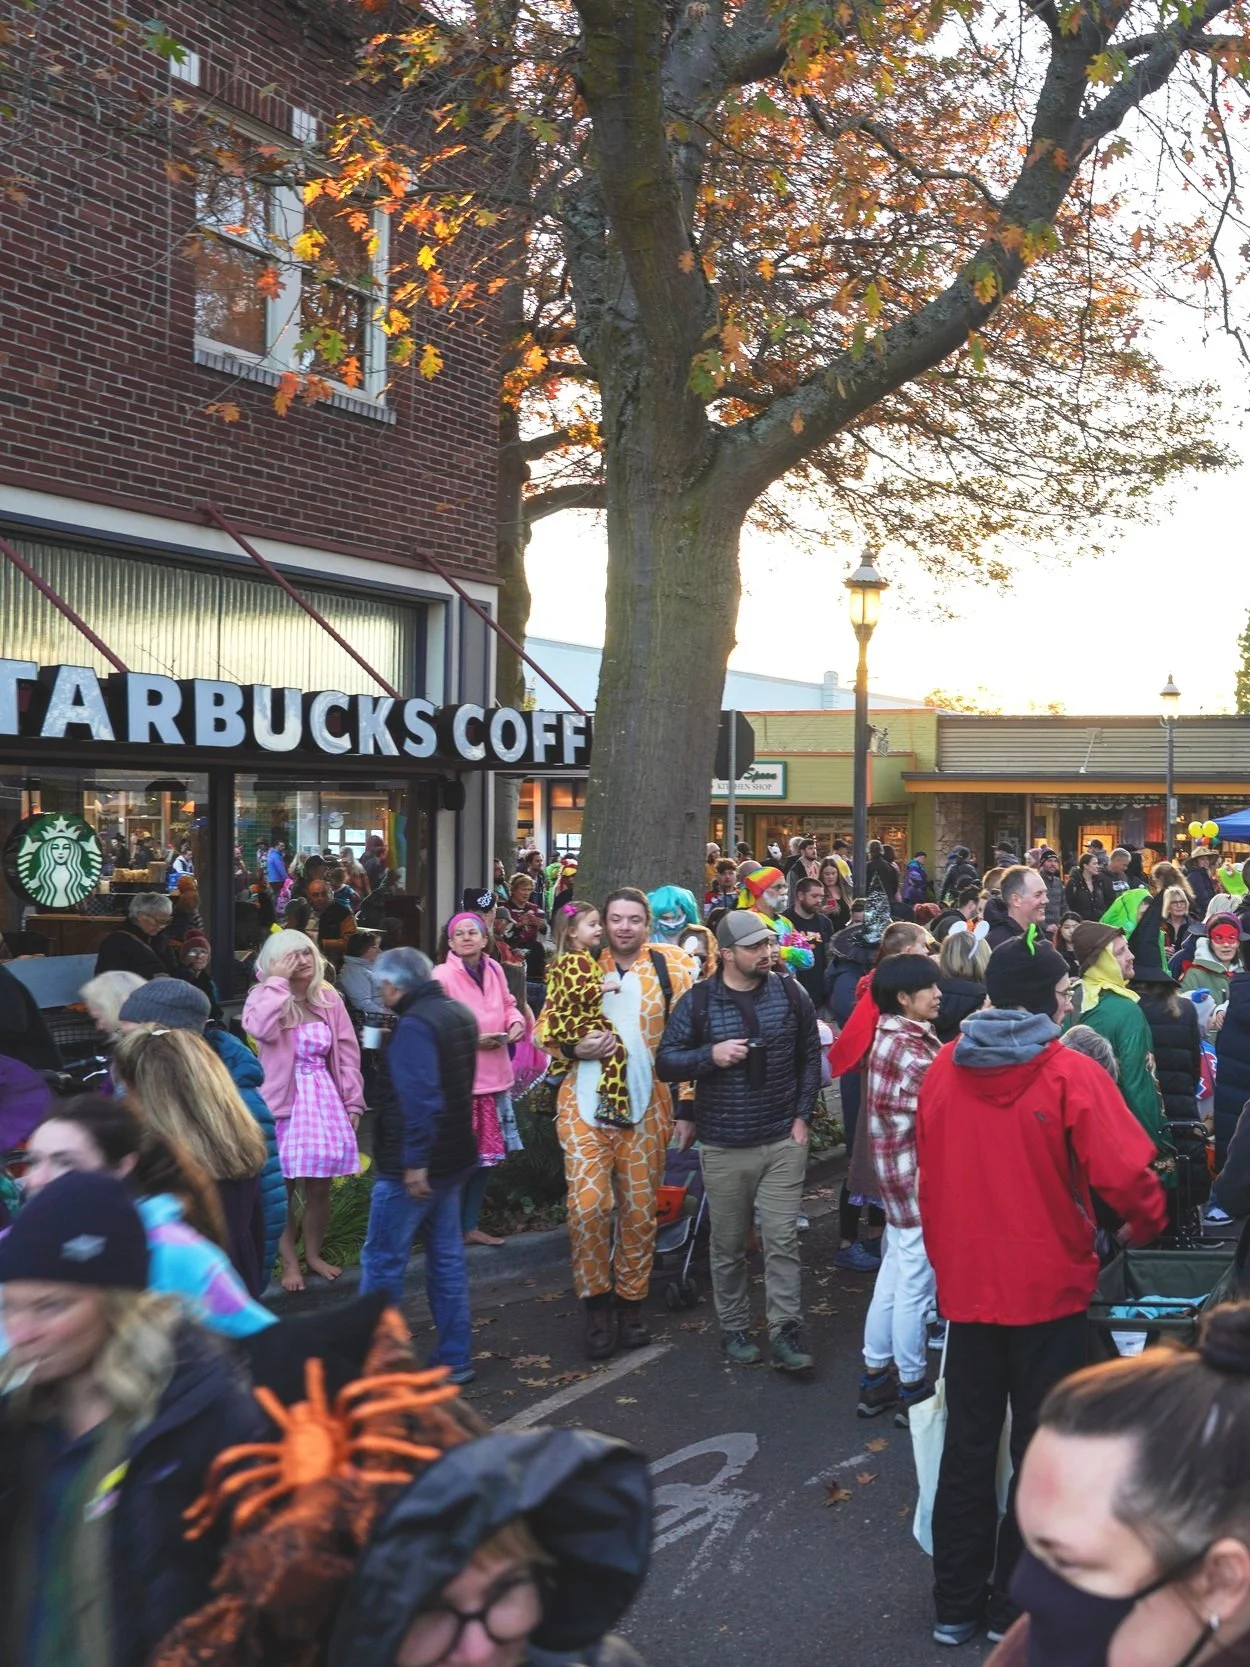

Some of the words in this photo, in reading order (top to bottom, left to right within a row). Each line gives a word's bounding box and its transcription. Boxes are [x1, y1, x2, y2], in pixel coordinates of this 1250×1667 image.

[453, 703, 586, 764] COFF
[717, 783, 750, 791] KITHEN
[752, 783, 772, 791] SHOP
